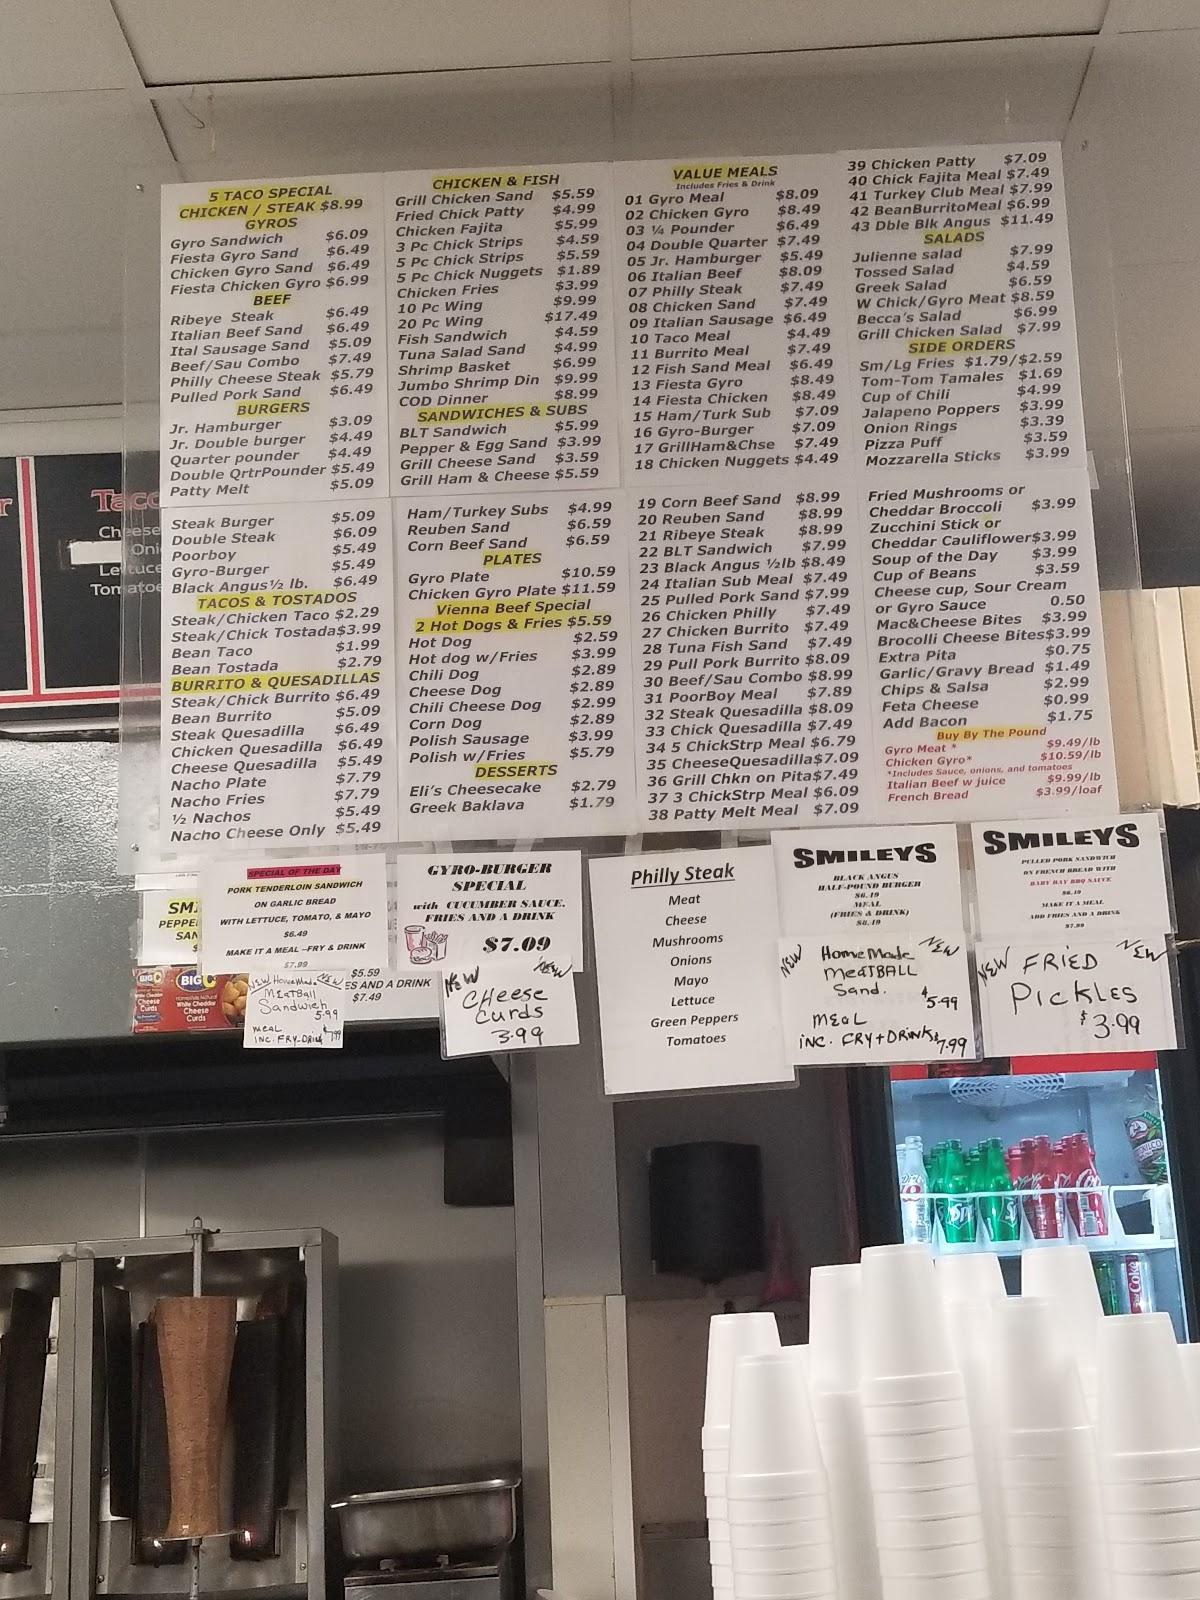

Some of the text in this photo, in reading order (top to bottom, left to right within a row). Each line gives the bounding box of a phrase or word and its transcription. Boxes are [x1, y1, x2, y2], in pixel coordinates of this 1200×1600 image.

[847, 152, 1047, 171] 39 Chicken Patty $7.09
[673, 166, 778, 180] VALUE MEALS
[433, 174, 560, 190] CHICKEN & FISH
[676, 182, 714, 190] Includes
[751, 179, 775, 187] Drink
[209, 185, 332, 202] 5 TACO SPECIAL
[395, 188, 595, 207] Grill Chicken Sand $5.59
[625, 189, 819, 207] 01 Gyro Meal $8.09
[180, 199, 363, 219] CHICKEN / STEAK $8.99
[245, 217, 298, 230] GYROS
[170, 229, 368, 251] Gyro Sandwich $6.09
[924, 231, 984, 244] SALADS
[253, 294, 292, 306] BEEF
[908, 339, 1015, 354] SIDE ORDERS
[237, 402, 310, 416] BURGERS
[417, 404, 588, 422] SANDWICHES & SUBS
[864, 415, 1064, 434] Onion Rings $3.39
[638, 491, 840, 509] 19 Corn Beef Sand $8.99
[483, 553, 542, 566] PLATES
[872, 546, 1077, 567] Soup of the Day $3.99
[198, 592, 357, 609] TACOS & TOSTADOS
[437, 599, 591, 615] Vienna Beef Special
[171, 672, 380, 692] BURRITO & QUESADILLAS
[937, 726, 1047, 741] Buy By The Pound
[475, 764, 558, 778] DESSERTS
[888, 784, 1103, 802] French Bread $3.99/loaf
[410, 796, 614, 814] Greek Baklava $1.79
[648, 802, 859, 822] 38 Patty Melt Meal $7.09
[983, 823, 1140, 855] SMILEYS
[793, 843, 937, 869] SMILEYS
[248, 866, 342, 878] SPECIAL OF THE DAY
[428, 863, 552, 875] GYRO-BURGER
[631, 862, 734, 888] Philly Steak
[227, 881, 363, 894] PORK TENDERLOIN SANDWICH
[452, 880, 526, 891] SPECIAL
[818, 883, 879, 891] HALF-POUND
[270, 899, 303, 907] GARLIC
[413, 902, 438, 910] with
[446, 900, 517, 909] CUCUMBER
[669, 894, 700, 906] Meat
[220, 918, 244, 926] WITH
[245, 916, 288, 924] LETTUCE,
[292, 913, 332, 922] TOMATO,
[344, 911, 371, 919] MAYO
[425, 911, 555, 922] FRIES AND A DRINK
[665, 915, 707, 926] Cheese
[483, 937, 551, 952] $7.09
[652, 935, 723, 948] Mushrooms
[274, 946, 299, 954] MEAL
[670, 955, 712, 967] Onions
[180, 975, 202, 986] BIG
[674, 976, 709, 988] Mayo
[671, 996, 715, 1007] Lettuce
[183, 1007, 210, 1015] Cheese
[186, 1014, 206, 1023] Curds
[651, 1014, 738, 1028] Green Peppers
[1080, 1010, 1140, 1039] $3.99
[667, 1035, 726, 1046] Tomatoes
